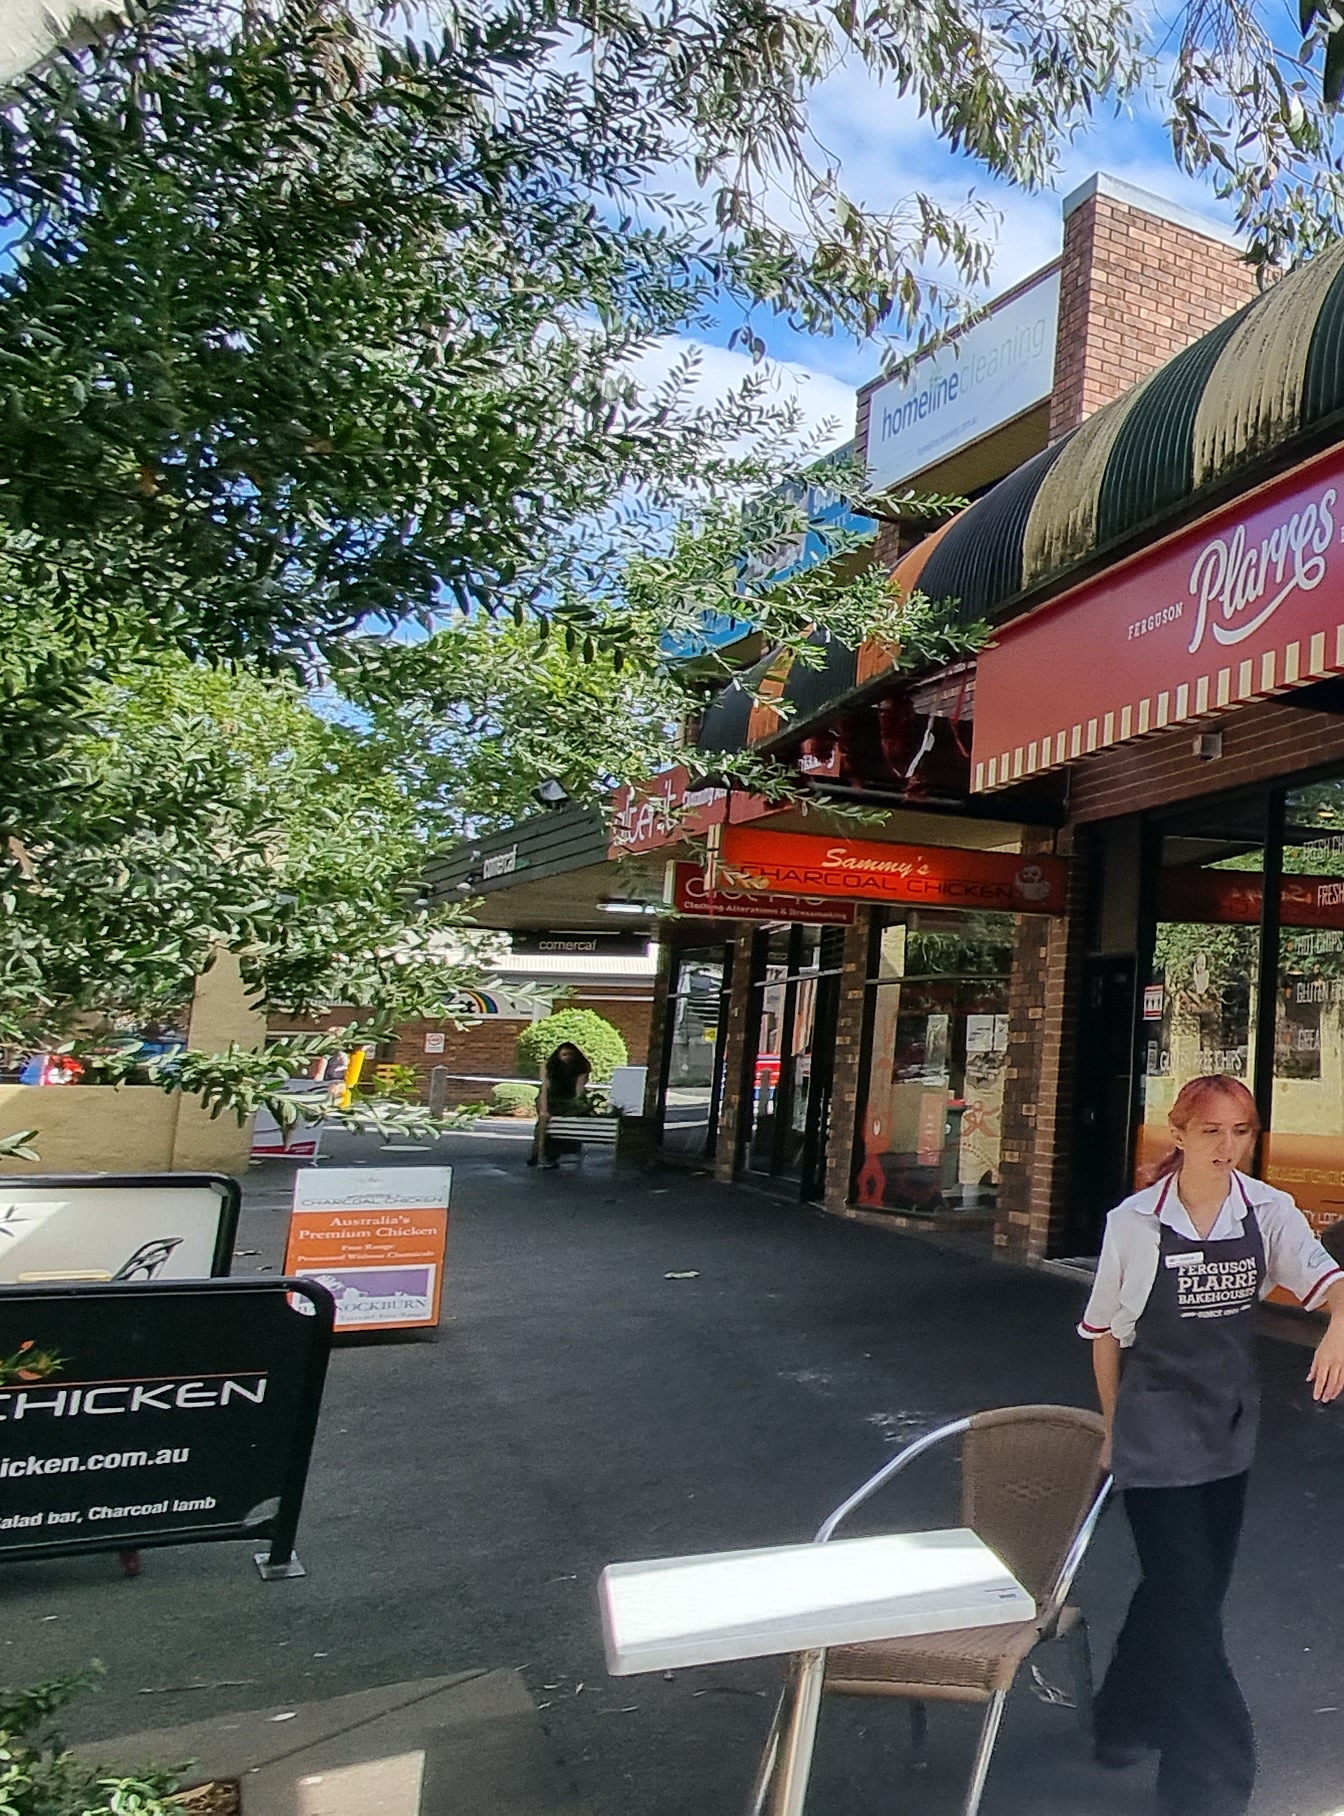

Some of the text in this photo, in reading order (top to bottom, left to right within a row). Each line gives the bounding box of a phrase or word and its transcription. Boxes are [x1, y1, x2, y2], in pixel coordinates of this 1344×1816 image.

[1127, 601, 1185, 641] FERGUSON
[821, 848, 932, 877] Sammy's
[741, 864, 898, 892] CHARCOAL
[906, 878, 1013, 899] CHICKEN
[1318, 883, 1344, 907] FRESH
[684, 901, 847, 920] Clothing Alterations & Dressmaking
[302, 1197, 380, 1206] CHARCOAL
[330, 1215, 410, 1227] Australia's
[299, 1227, 437, 1240] Premium Chicken
[365, 1243, 395, 1251] Range
[1178, 1256, 1256, 1276] FERGUSON
[1178, 1270, 1257, 1293] PLARRE
[337, 1300, 427, 1312] OCKBURN
[0, 1378, 267, 1420] HICKEN
[0, 1448, 190, 1478] icken.com.au
[47, 1510, 83, 1525] bar,
[88, 1501, 168, 1521] Charcoal
[173, 1496, 216, 1513] lamb
